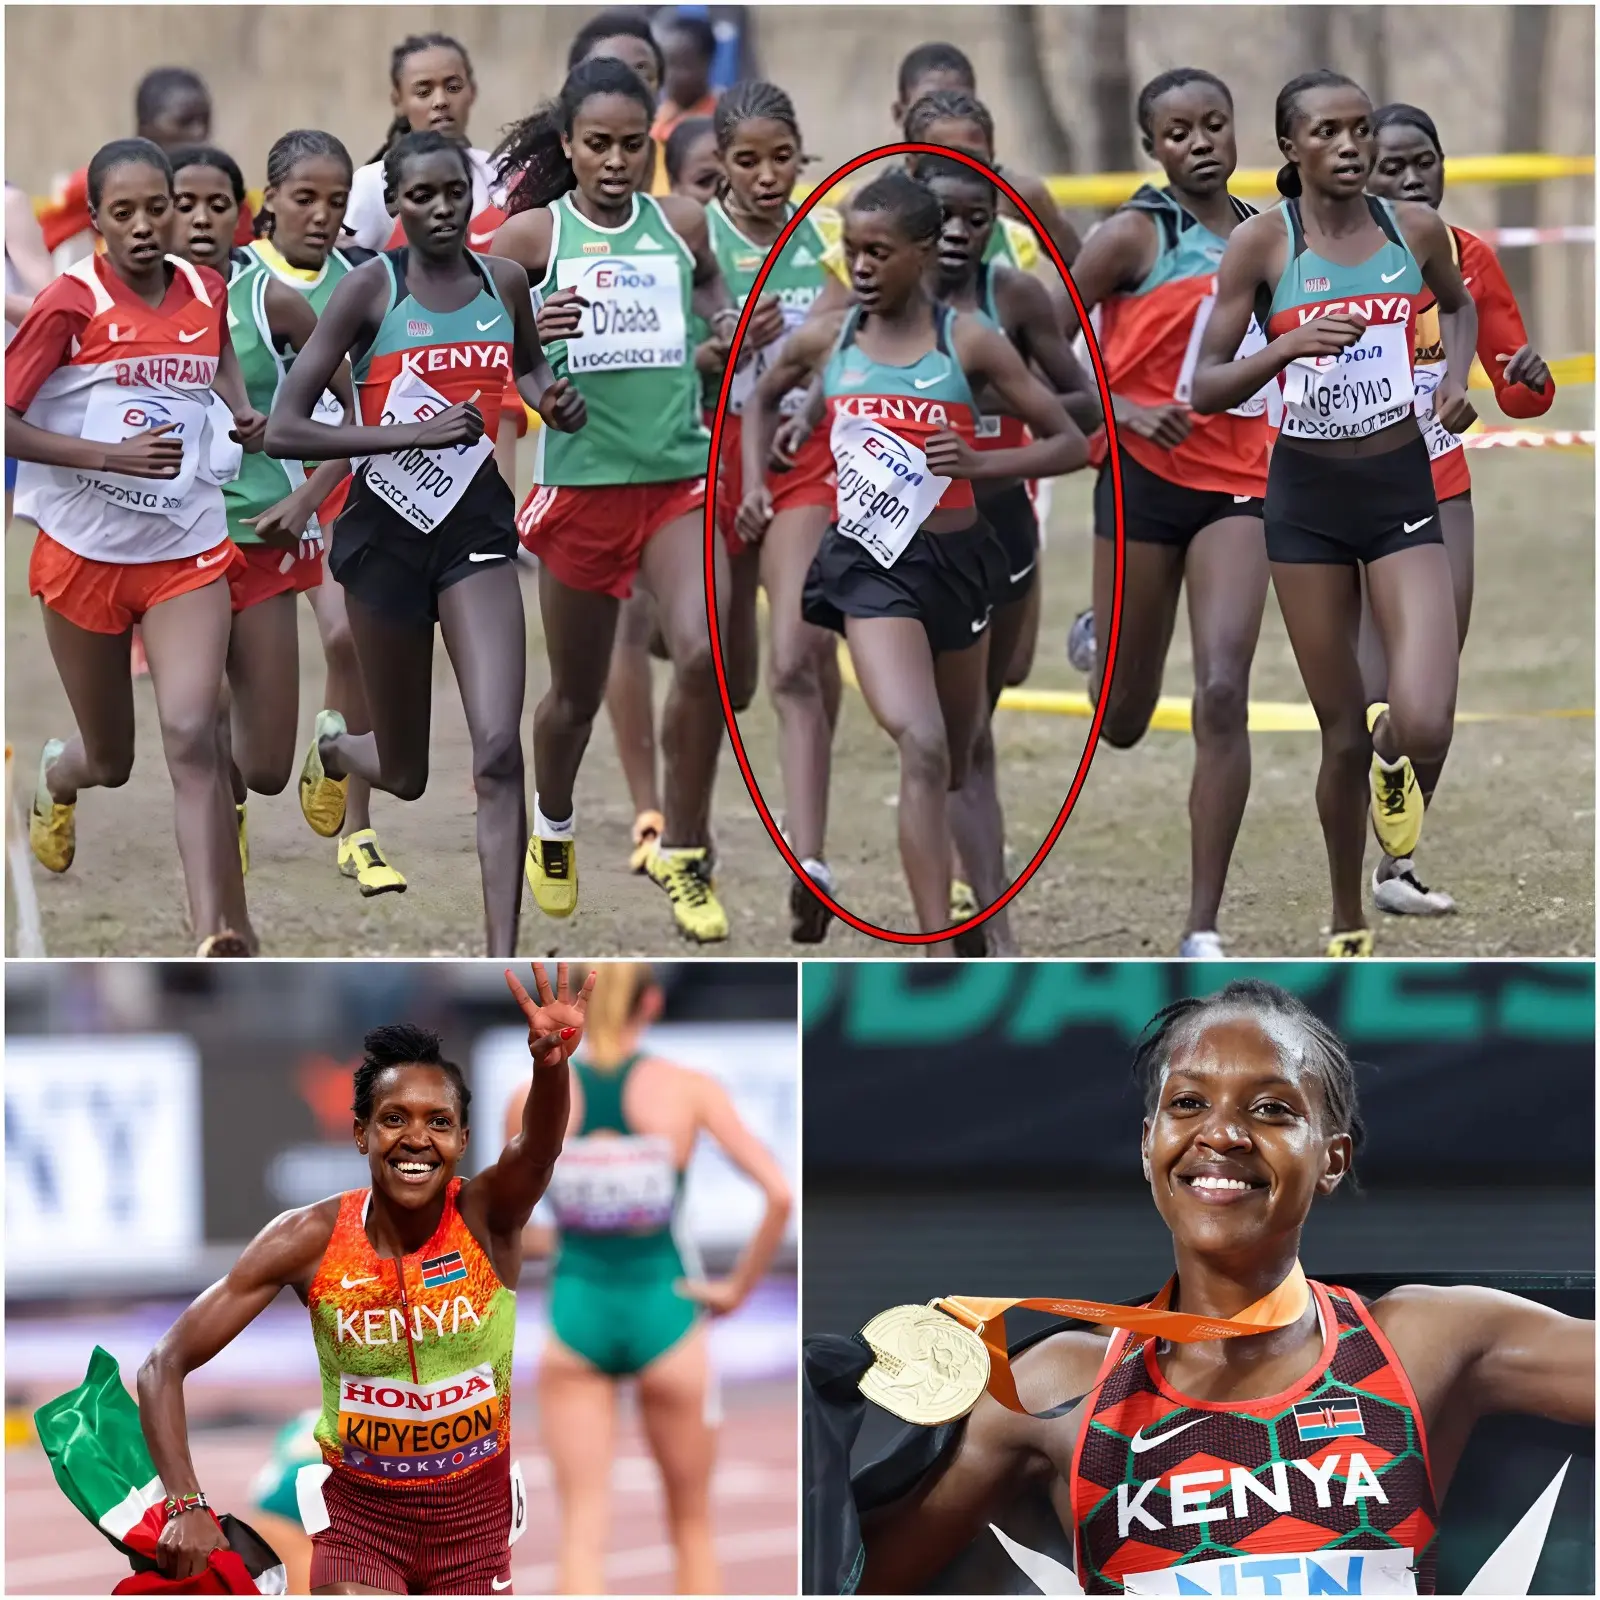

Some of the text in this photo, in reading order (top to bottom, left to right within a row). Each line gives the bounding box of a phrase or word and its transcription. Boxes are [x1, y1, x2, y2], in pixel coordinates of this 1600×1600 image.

[401, 344, 510, 375] KENYA
[833, 397, 948, 425] KENYA
[336, 1295, 481, 1346] KENYA
[344, 1375, 490, 1411] HONDA
[346, 1405, 492, 1452] KIPYEGON
[1117, 1453, 1390, 1538] KENYA
